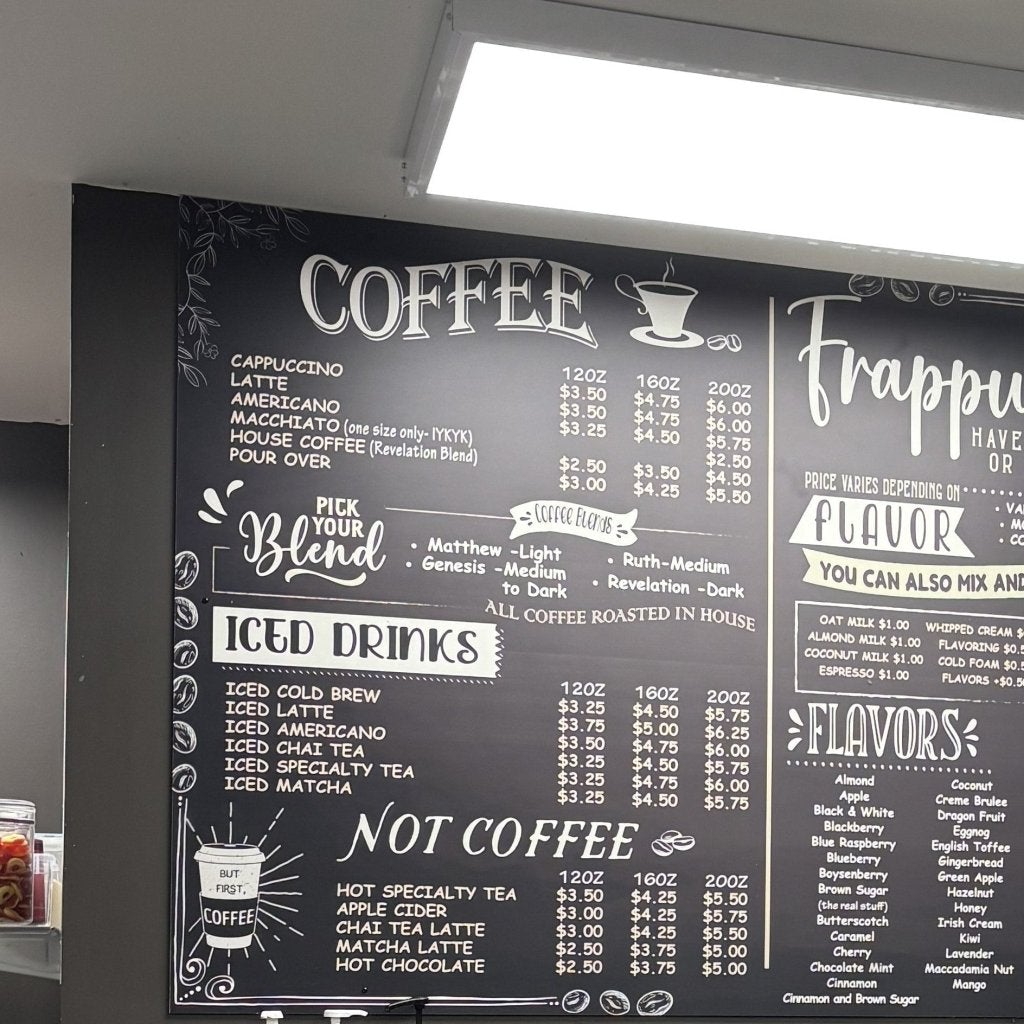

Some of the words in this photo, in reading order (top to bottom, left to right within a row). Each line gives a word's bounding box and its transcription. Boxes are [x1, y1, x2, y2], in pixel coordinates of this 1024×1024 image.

[299, 253, 598, 349] COFFEE
[232, 354, 343, 377] CAPPUCCINO
[231, 372, 288, 391] LATTE
[560, 383, 606, 401] $3.50
[634, 390, 680, 408] $4.75
[231, 392, 340, 414] AMERICANO
[707, 398, 751, 416] $6.00
[231, 411, 340, 432] MACCHIATO
[372, 420, 397, 441] size
[231, 429, 292, 447] HOUSE
[300, 436, 366, 454] COFFEE
[370, 440, 436, 459] (Revelation
[441, 447, 477, 466] Blend)
[972, 427, 1021, 450] HAVE
[990, 453, 1012, 473] OR
[805, 472, 836, 490] PRICE
[842, 474, 878, 494] VARIES
[883, 479, 942, 499] DEPENDING
[947, 484, 960, 501] ON
[317, 497, 360, 517] PICK
[312, 517, 364, 537] YOUR
[815, 500, 950, 552] FLAVOR
[238, 511, 386, 577] Blend
[428, 538, 502, 556] Matthew
[422, 556, 485, 574] Genesis
[608, 574, 689, 594] Revelation
[820, 561, 856, 585] YOU
[863, 570, 899, 590] CAN
[906, 573, 952, 592] ALSO
[958, 574, 987, 592] MIX
[502, 582, 519, 595] to
[528, 582, 567, 598] Dark
[485, 599, 519, 620] ALL
[524, 609, 586, 624] COFFEE
[592, 607, 670, 624] ROASTED
[676, 607, 695, 620] IN
[701, 608, 755, 632] HOUSE
[820, 615, 843, 625] OAT
[848, 617, 874, 628] MILK
[879, 618, 909, 630] $1.00
[224, 617, 315, 655] ICED
[332, 621, 478, 665] DRINKS
[226, 682, 269, 697] ICED
[278, 685, 323, 700] COLD
[332, 687, 380, 703] BREW
[558, 698, 605, 715] $3.25
[633, 702, 678, 719] $4.50
[705, 706, 749, 723] $5.75
[806, 703, 960, 760] FLAVORS
[835, 774, 874, 786] Almond
[952, 780, 993, 790] Coconut
[337, 802, 453, 861] NOT
[463, 817, 638, 859] COFFEE
[954, 825, 990, 839] Eggnog
[220, 870, 239, 878] BUT
[337, 883, 375, 897] HOT
[383, 885, 476, 900] SPECIALTY
[483, 887, 516, 900] TEA
[204, 908, 254, 925] COFFEE
[817, 914, 888, 926] Butterscotch
